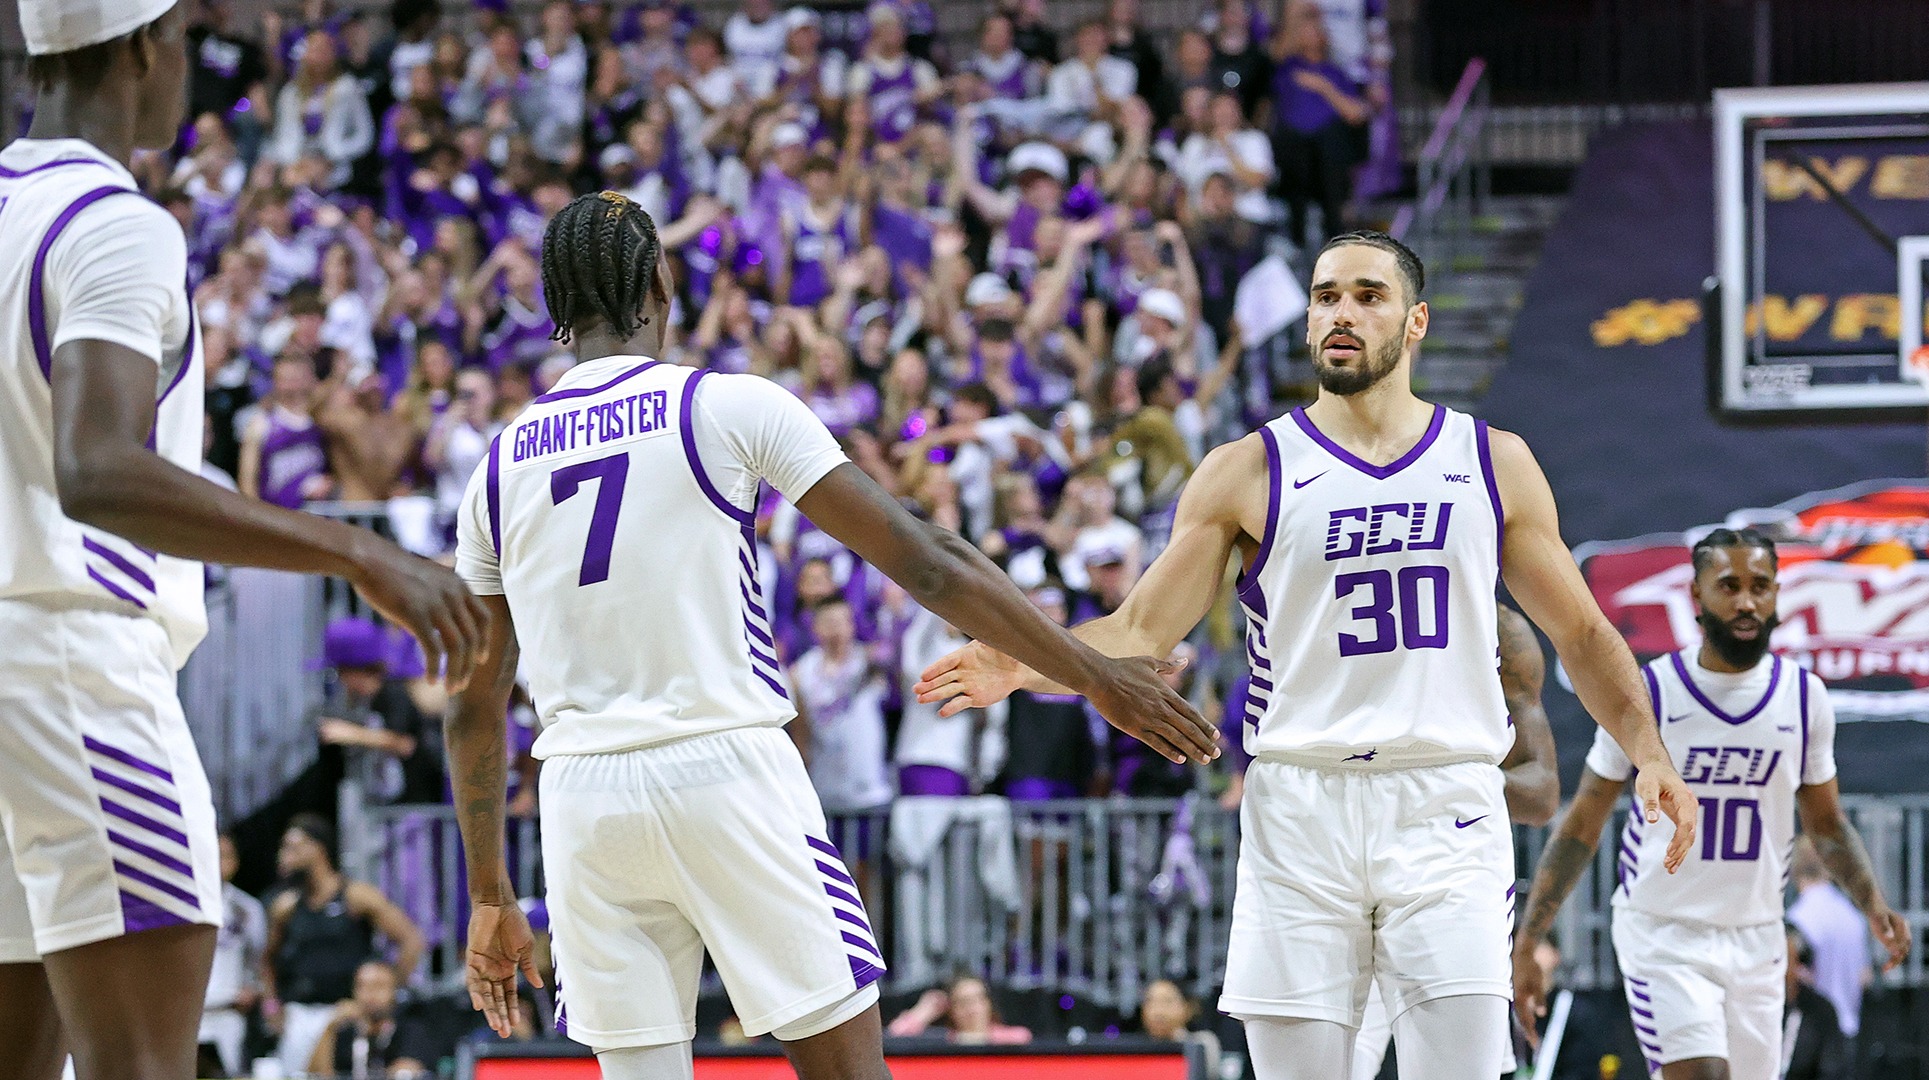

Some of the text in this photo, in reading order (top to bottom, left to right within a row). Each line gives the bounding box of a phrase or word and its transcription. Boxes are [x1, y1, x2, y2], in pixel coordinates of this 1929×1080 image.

[513, 390, 667, 462] GRANT-FOSTER
[1442, 473, 1471, 484] WAC
[551, 452, 630, 587] 7
[1325, 502, 1455, 561] GCU
[1335, 565, 1450, 657] 30
[1682, 746, 1782, 786] GCU
[1697, 797, 1762, 861] 10
